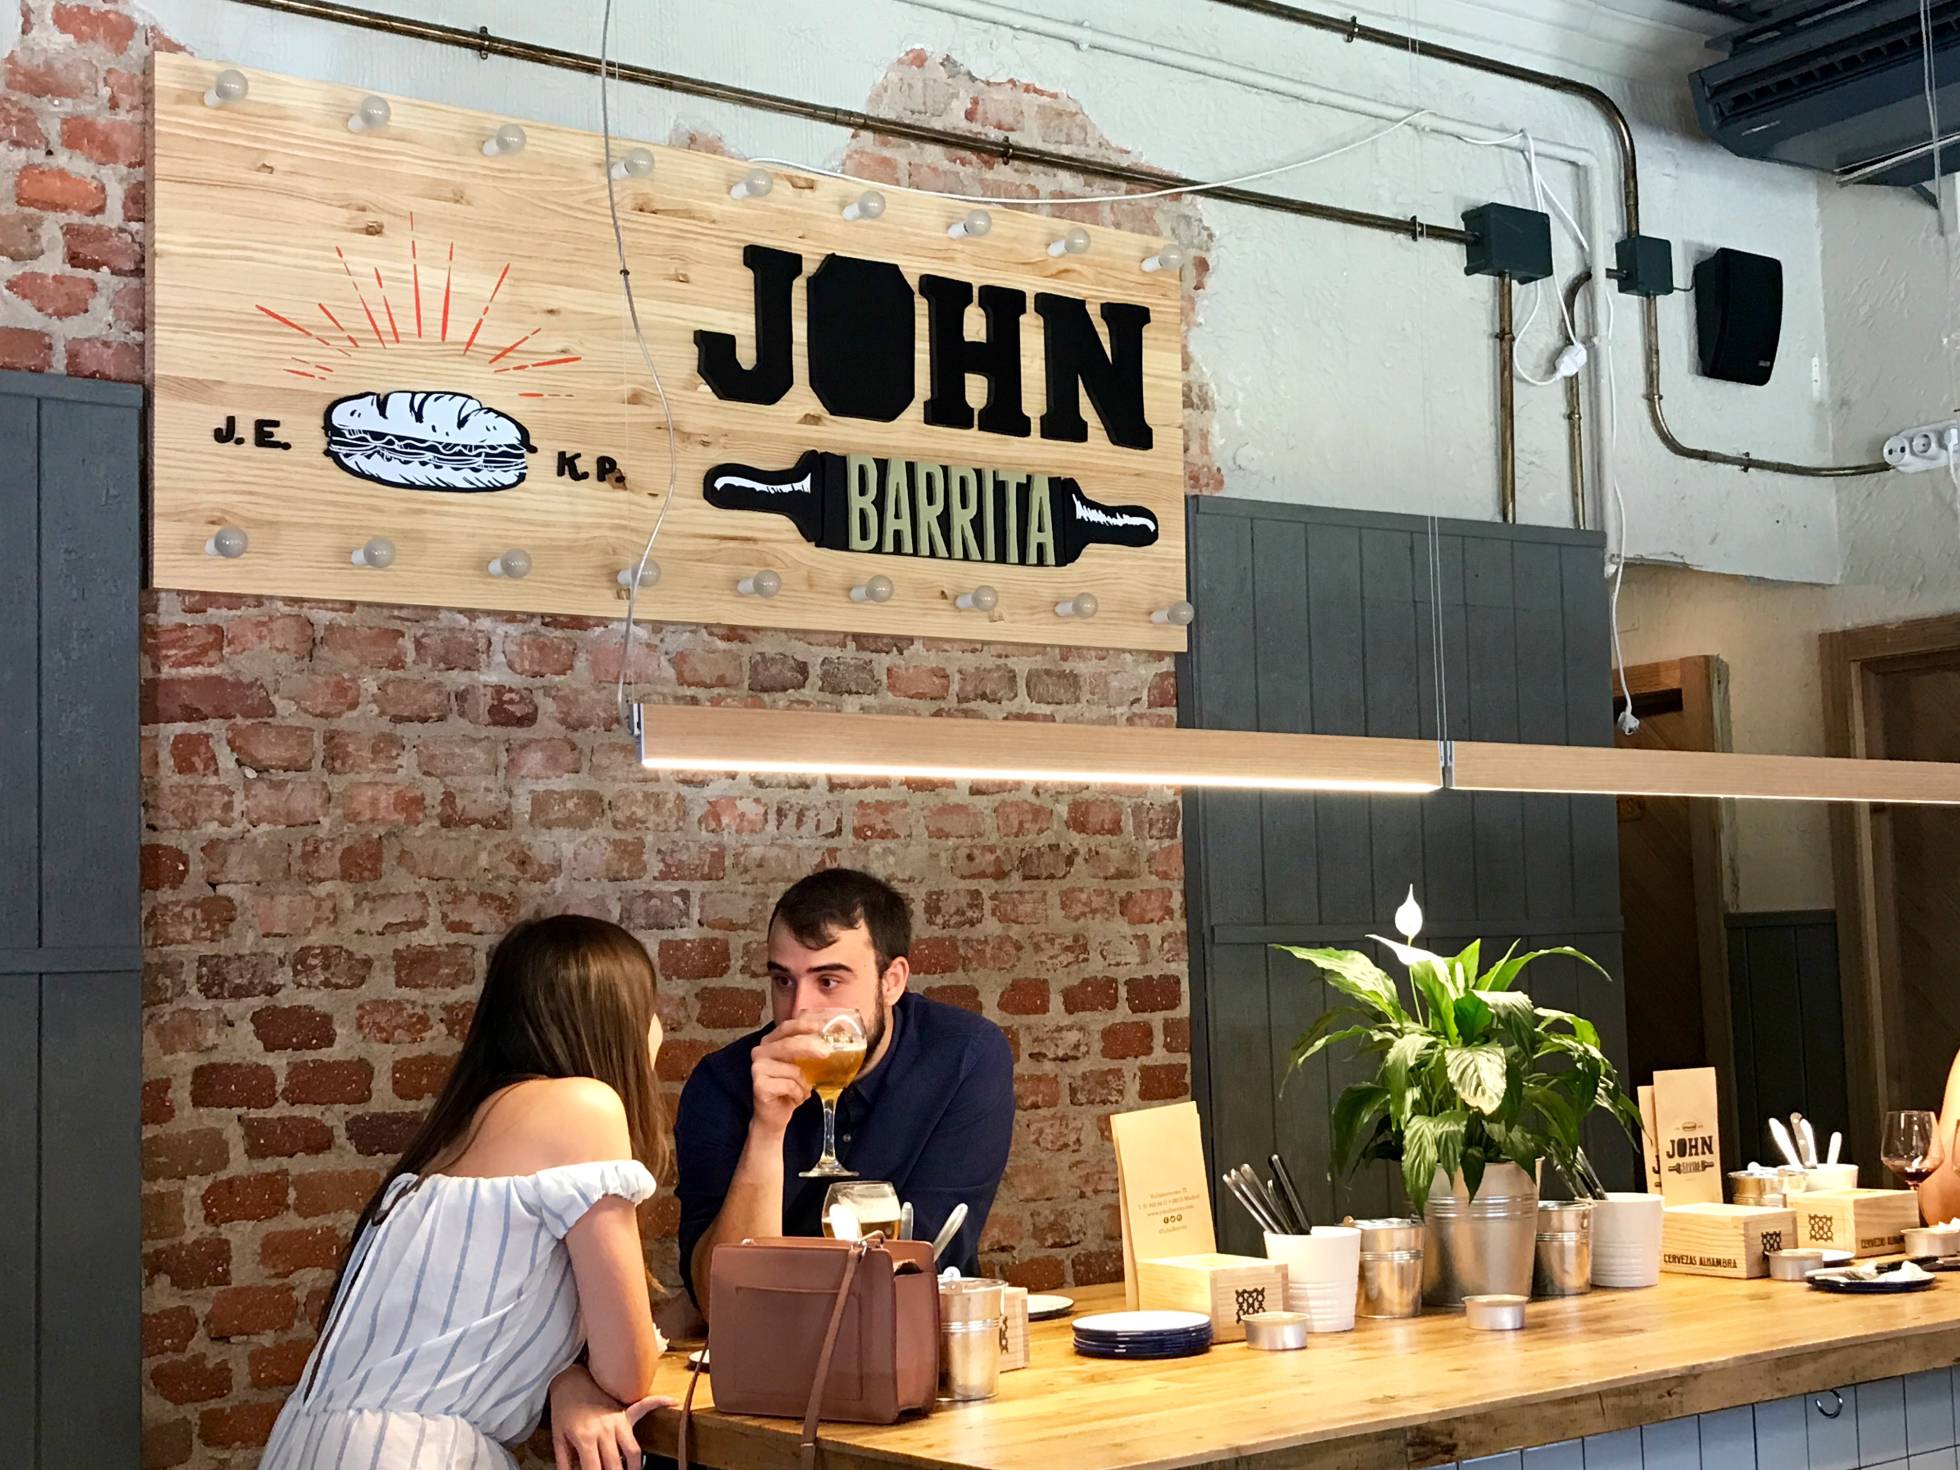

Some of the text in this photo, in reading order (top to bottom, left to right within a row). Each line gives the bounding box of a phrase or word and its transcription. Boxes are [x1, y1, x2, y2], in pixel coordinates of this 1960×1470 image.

[693, 244, 1154, 450] JOHN
[846, 453, 1056, 566] BARRITA
[1666, 1136, 1714, 1158] JOHN
[1663, 1253, 1738, 1269] CERVEZAS ALHAMBRA
